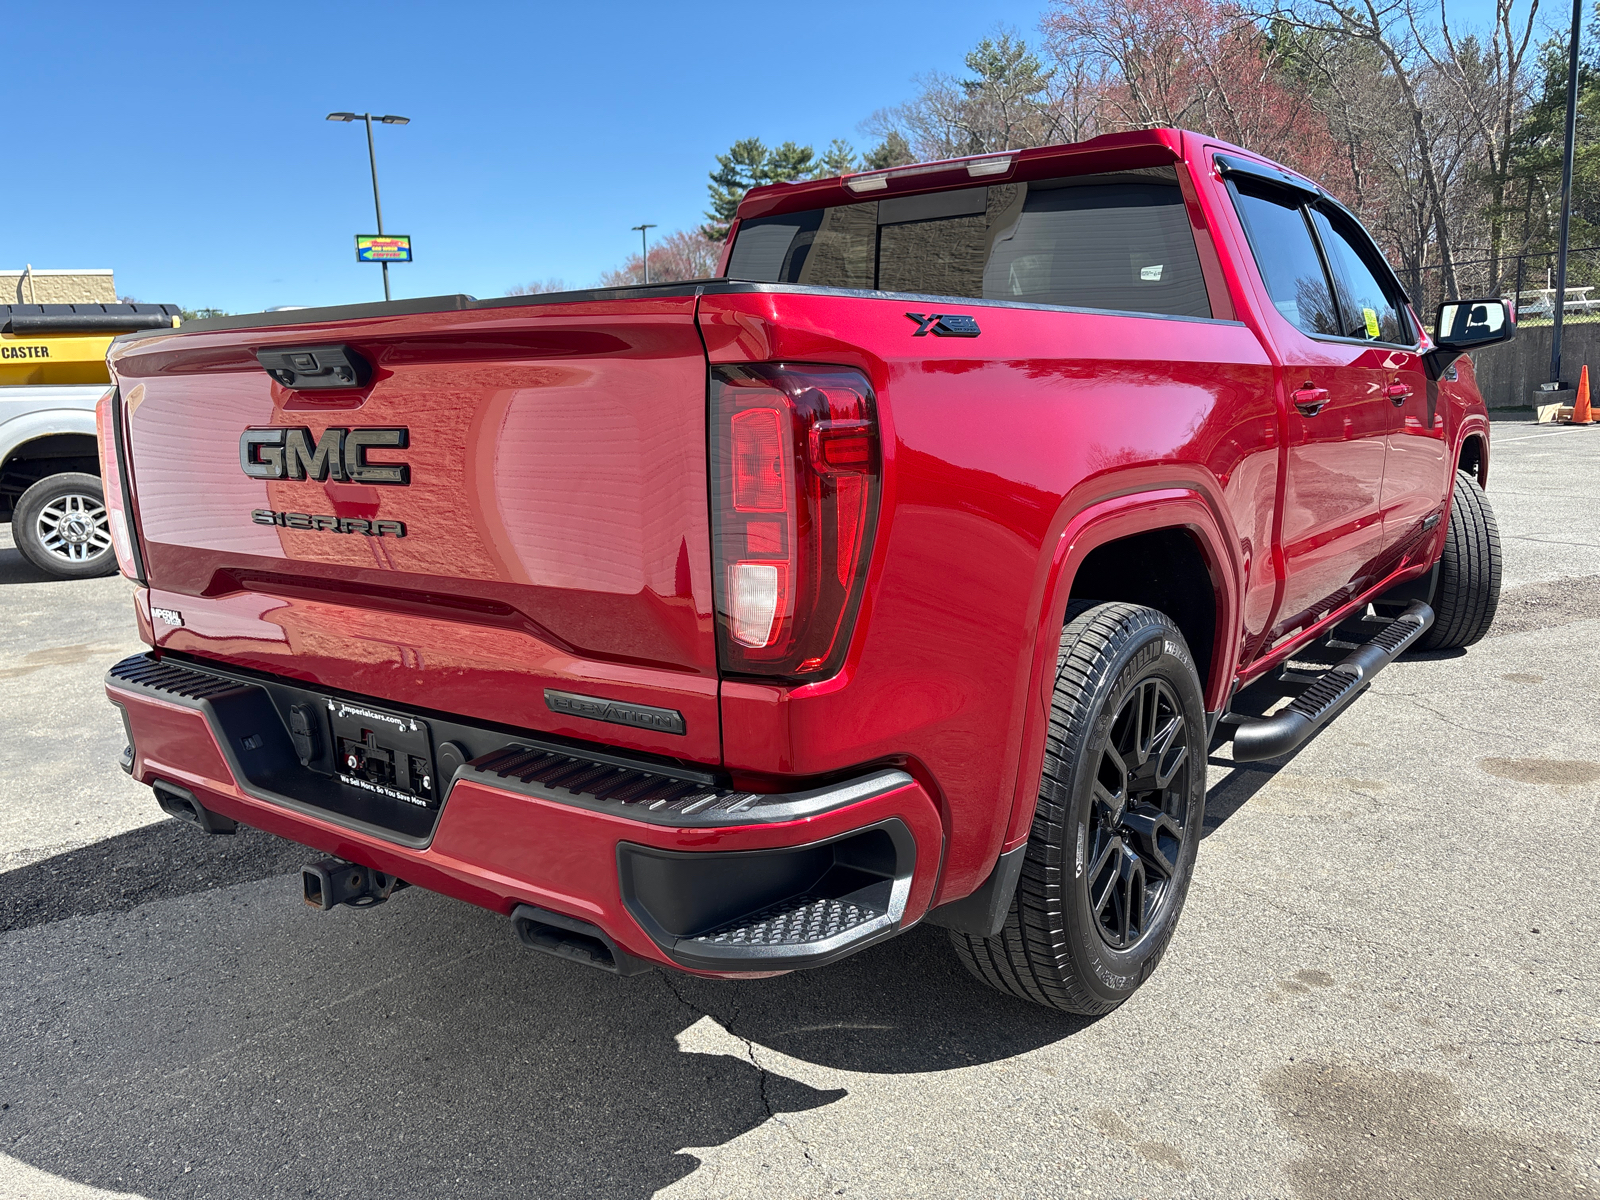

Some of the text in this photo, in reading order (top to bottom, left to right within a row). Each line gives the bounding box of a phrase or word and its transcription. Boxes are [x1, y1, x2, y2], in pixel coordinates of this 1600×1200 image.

[1, 346, 49, 359] CASTER
[239, 427, 410, 486] GMC
[251, 508, 407, 538] SIERRA
[341, 704, 402, 725] Imperialcars.com
[553, 698, 672, 728] ELEVATION
[340, 774, 350, 784] We
[349, 778, 360, 787] Sell
[376, 786, 384, 794] So
[384, 788, 396, 798] You
[396, 792, 410, 802] Save
[411, 796, 427, 808] More
